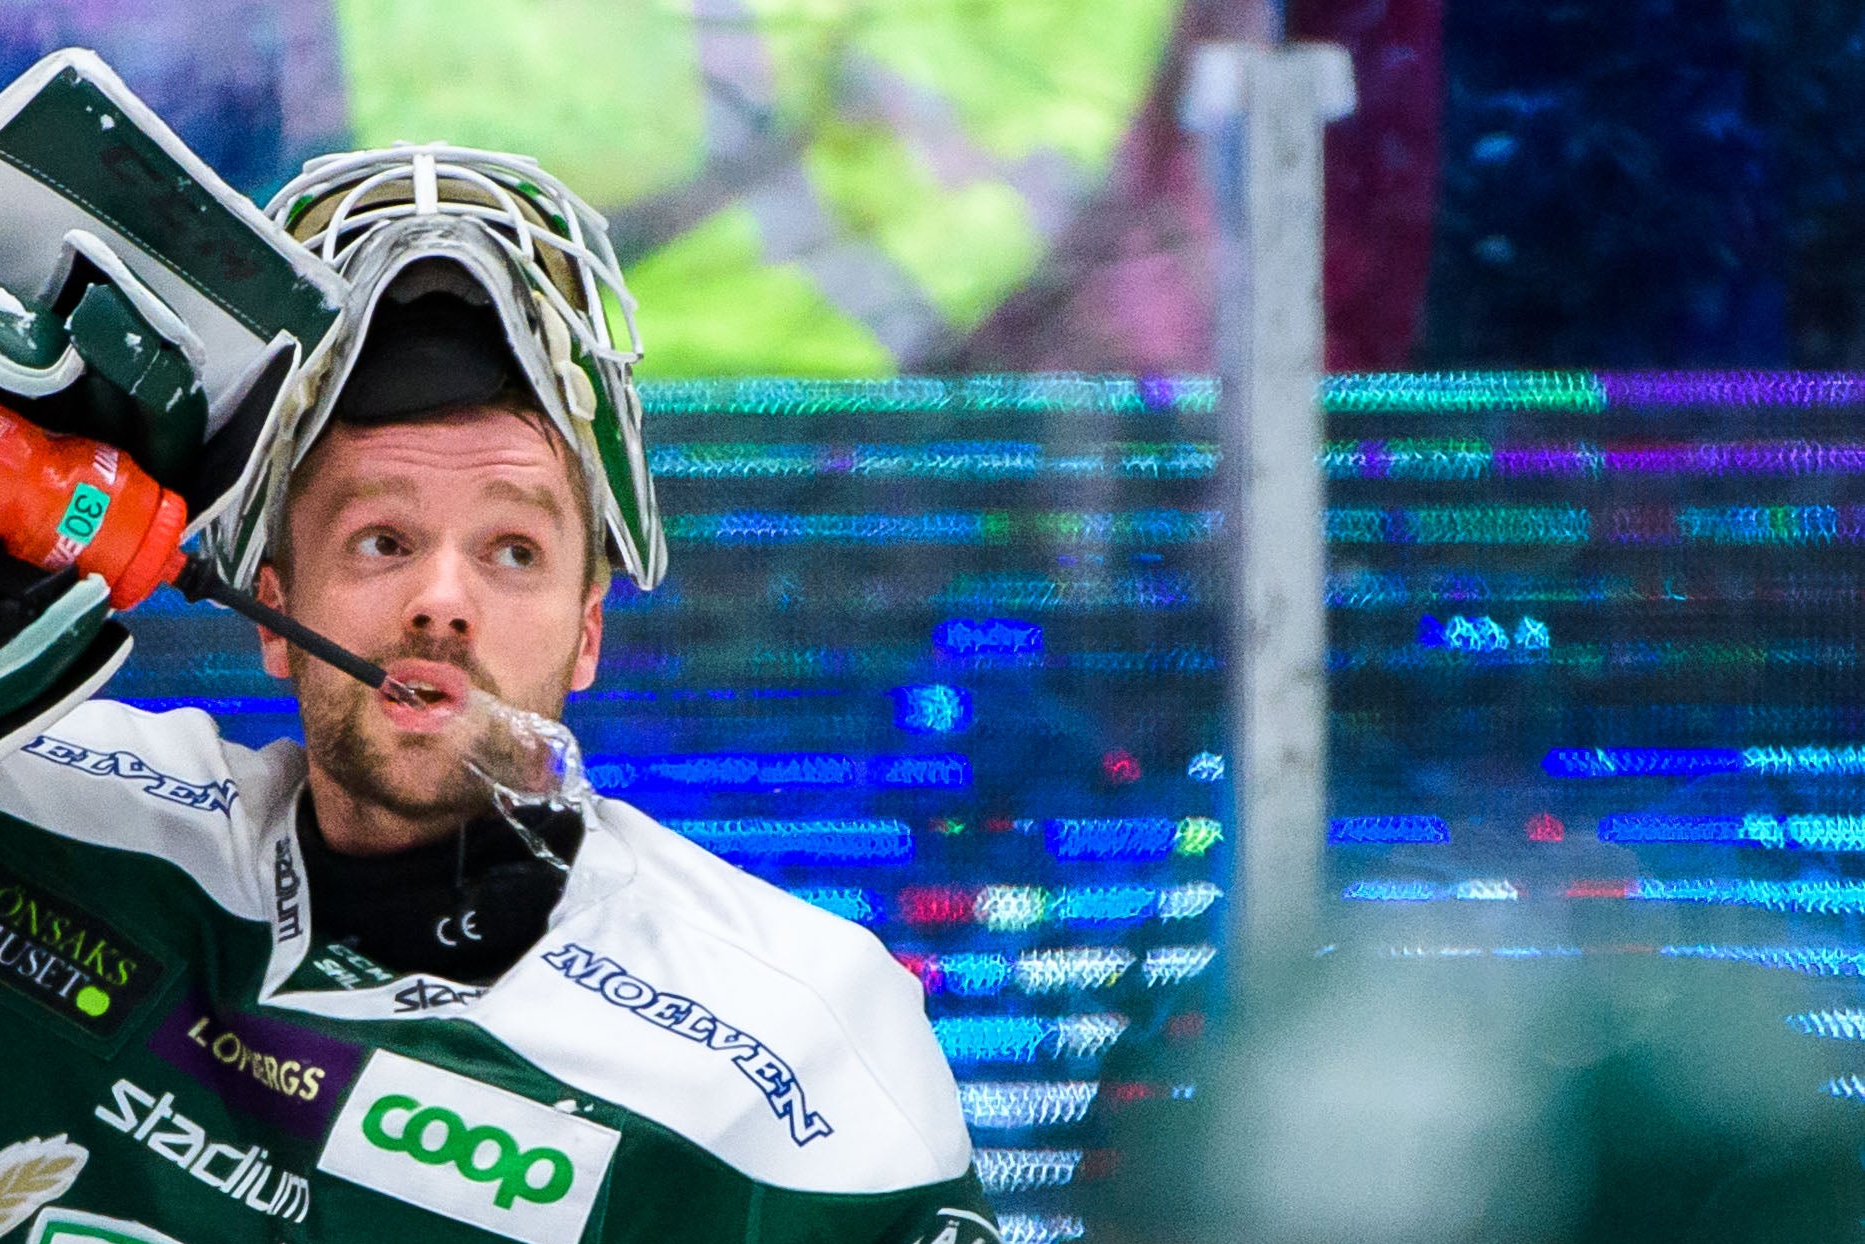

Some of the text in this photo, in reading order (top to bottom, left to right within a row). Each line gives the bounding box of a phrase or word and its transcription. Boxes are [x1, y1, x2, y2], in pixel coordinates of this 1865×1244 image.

[64, 494, 103, 539] 30
[540, 942, 835, 1147] MOELVEN
[94, 1077, 311, 1224] stadium
[362, 1093, 574, 1211] coop
